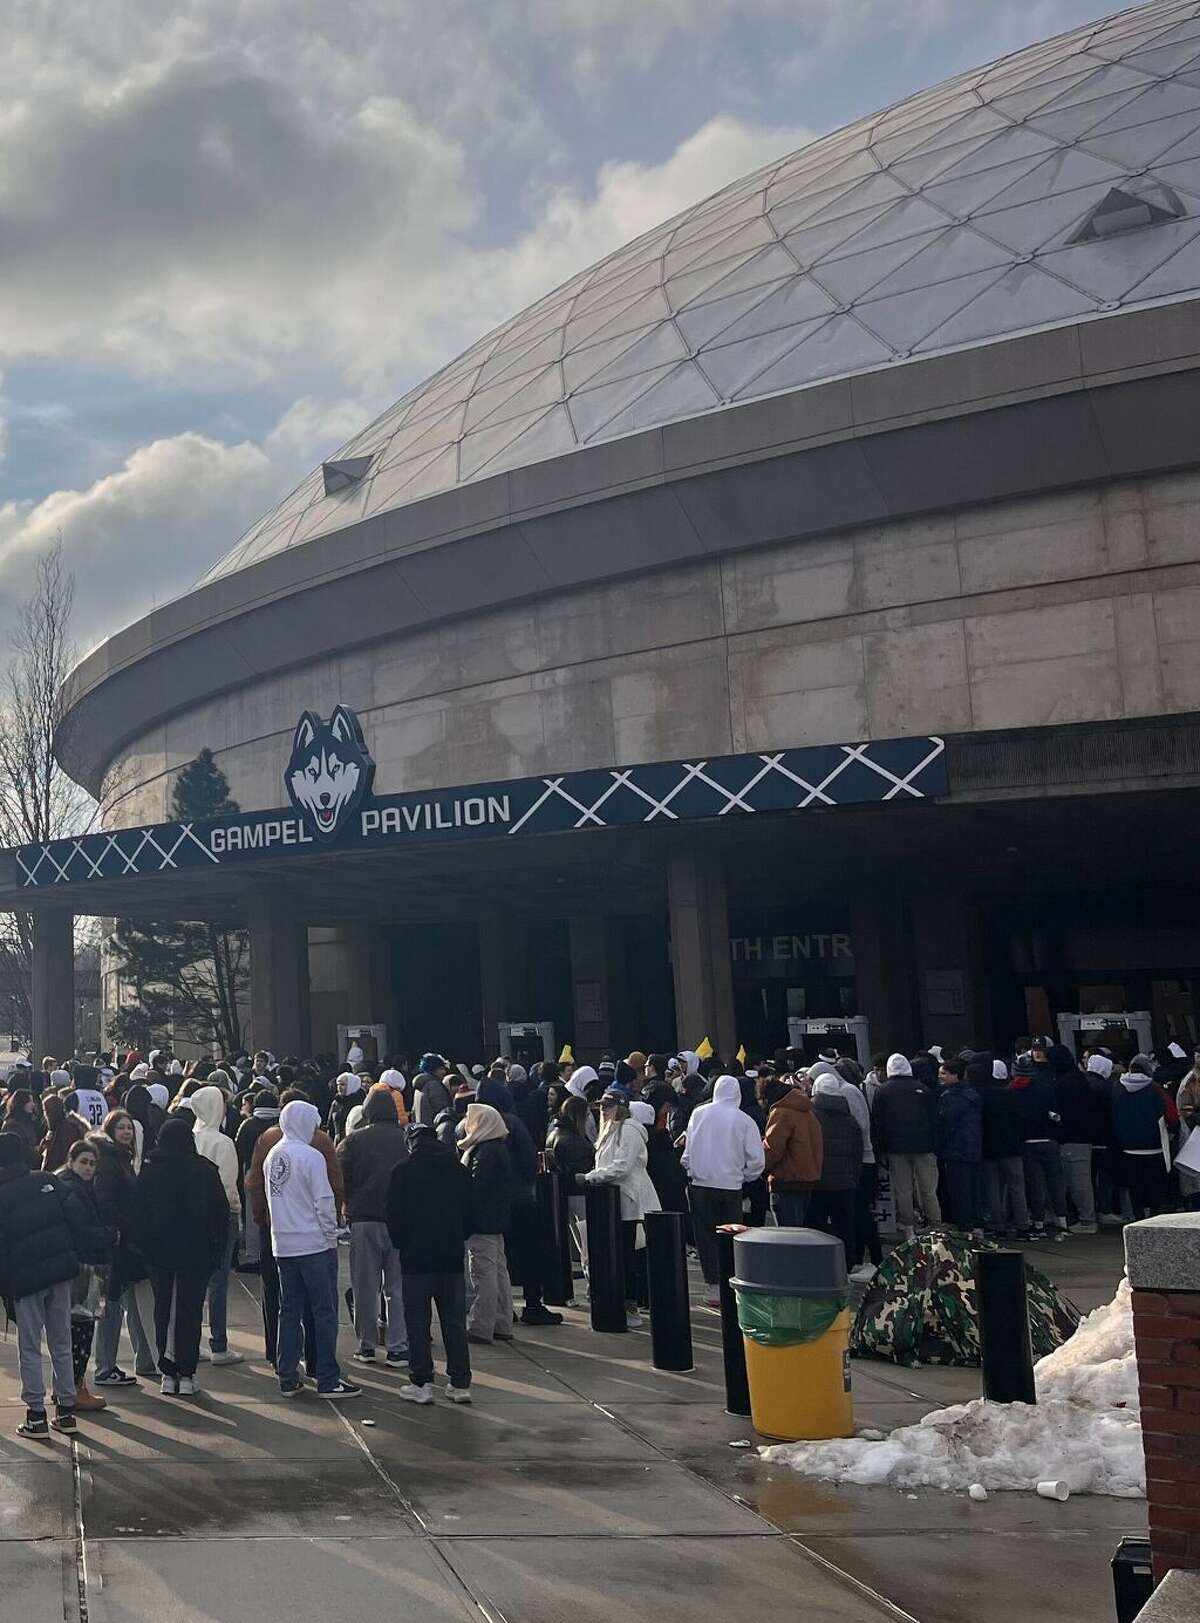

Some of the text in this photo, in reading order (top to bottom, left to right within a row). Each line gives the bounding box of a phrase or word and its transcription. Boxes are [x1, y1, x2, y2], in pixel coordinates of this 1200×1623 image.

[210, 795, 510, 853] GAMPEL PAVILION
[89, 1104, 103, 1126] 32
